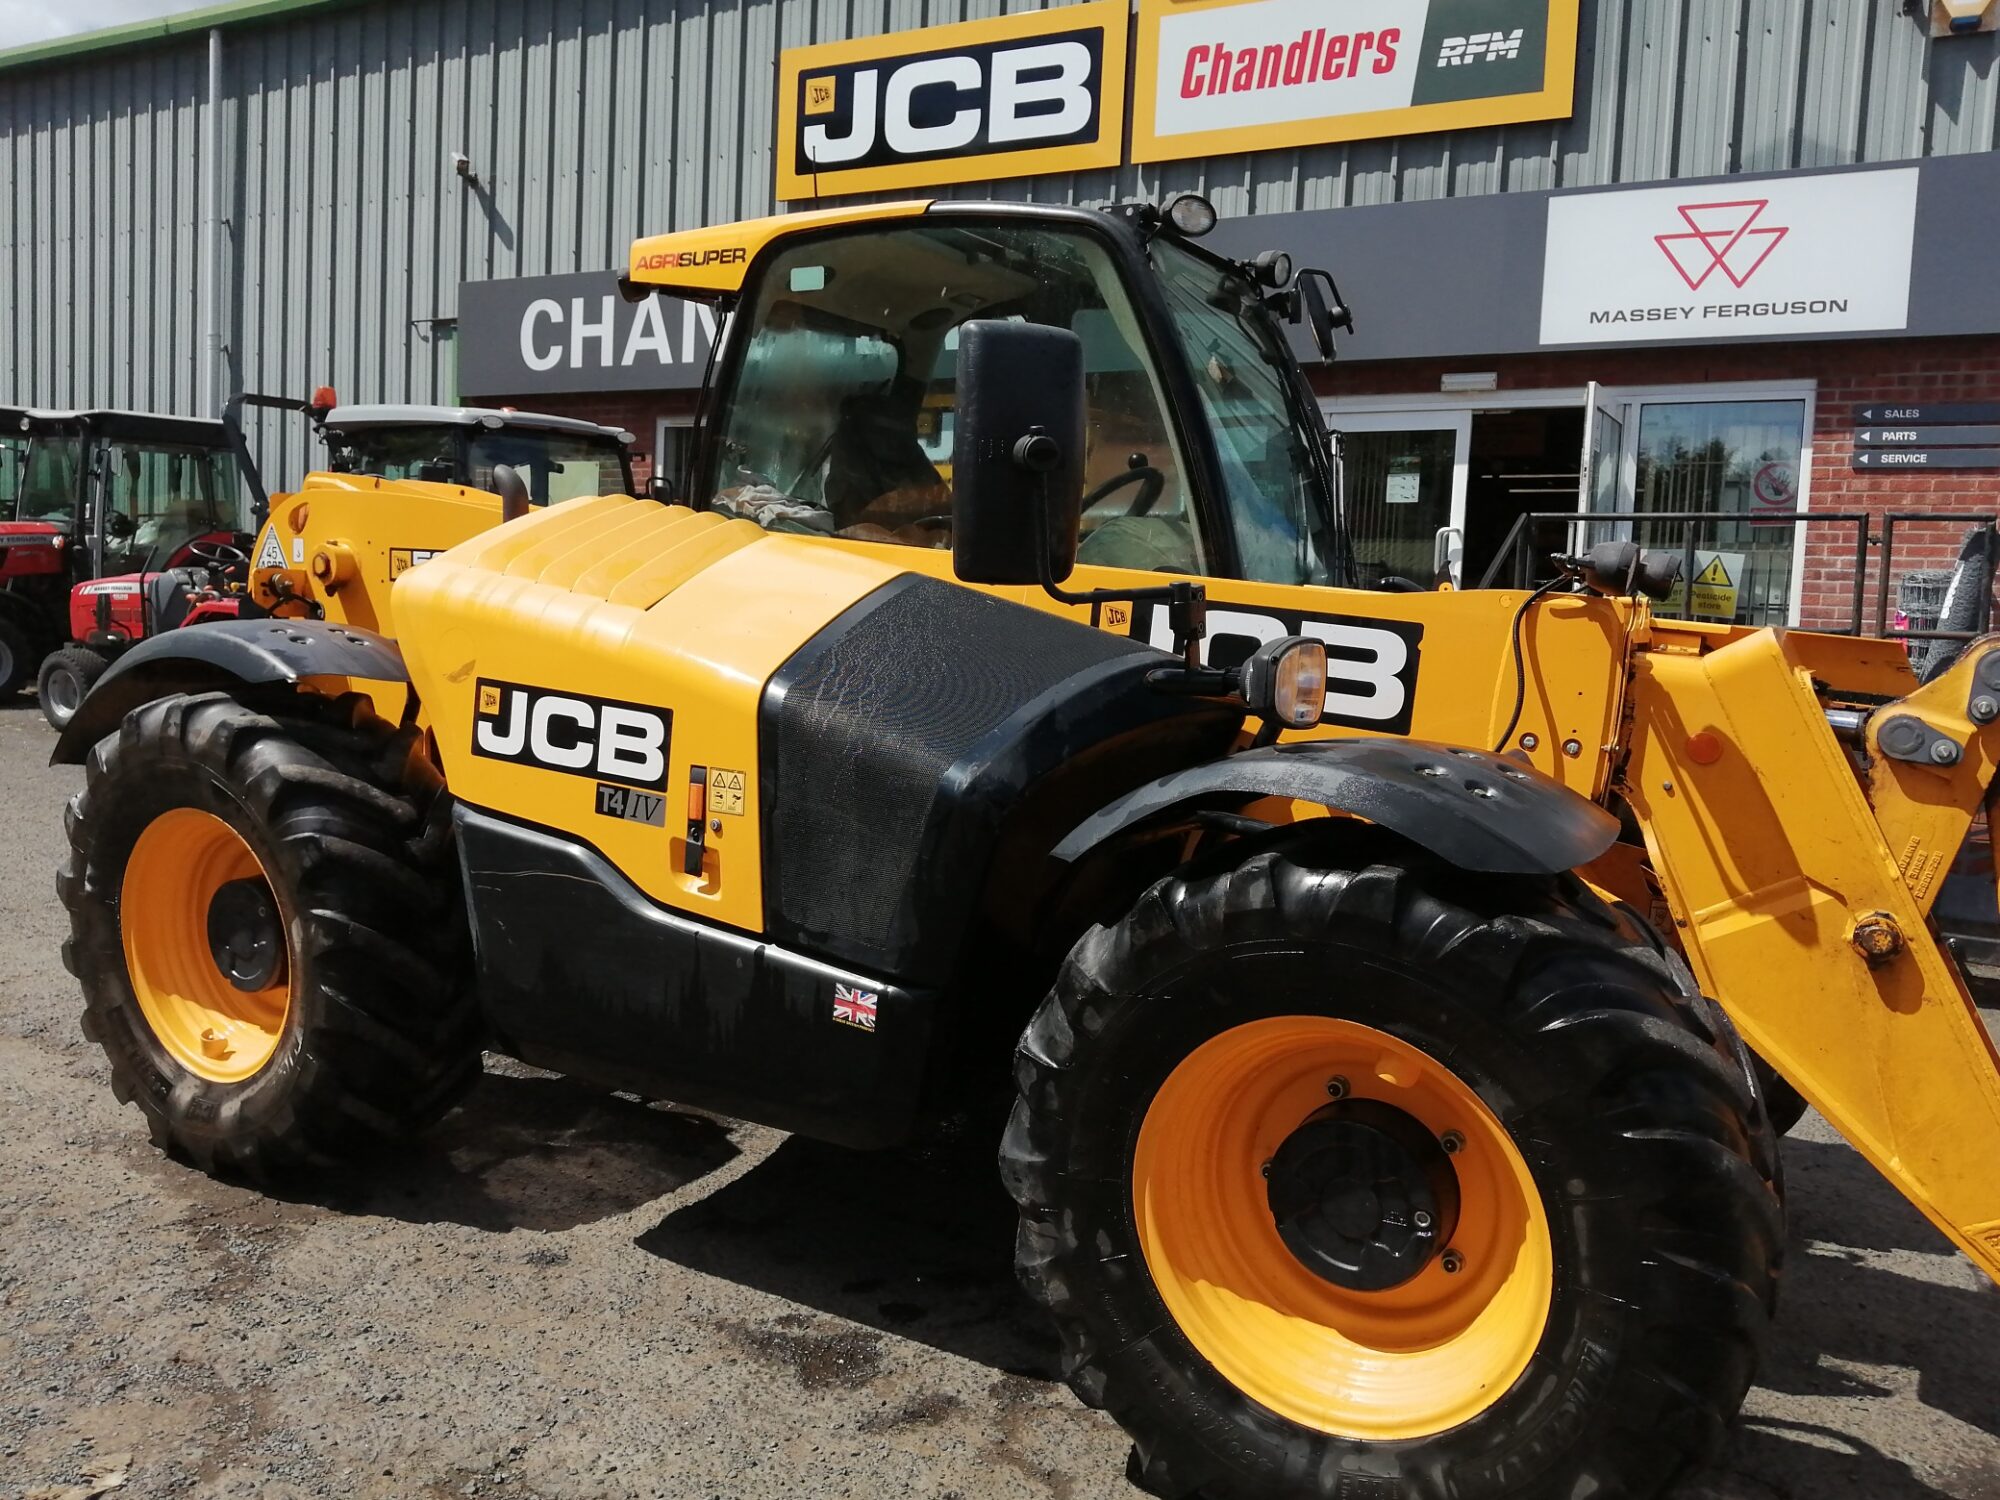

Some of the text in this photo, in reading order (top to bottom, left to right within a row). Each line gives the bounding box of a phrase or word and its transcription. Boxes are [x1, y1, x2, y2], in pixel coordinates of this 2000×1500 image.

[1437, 28, 1524, 68] RFM
[1180, 28, 1401, 99] Chandlers
[804, 42, 1092, 164] JCB
[812, 85, 830, 104] JCB
[635, 247, 747, 272] AGRISUPER
[1590, 299, 1849, 325] MASSEY FERGUSON
[1884, 409, 1920, 419] SALES
[1882, 431, 1917, 441] PARTS
[1881, 454, 1927, 464] SERVICE
[267, 546, 278, 560] 45
[1107, 604, 1127, 624] JCB
[477, 690, 665, 782] JCB
